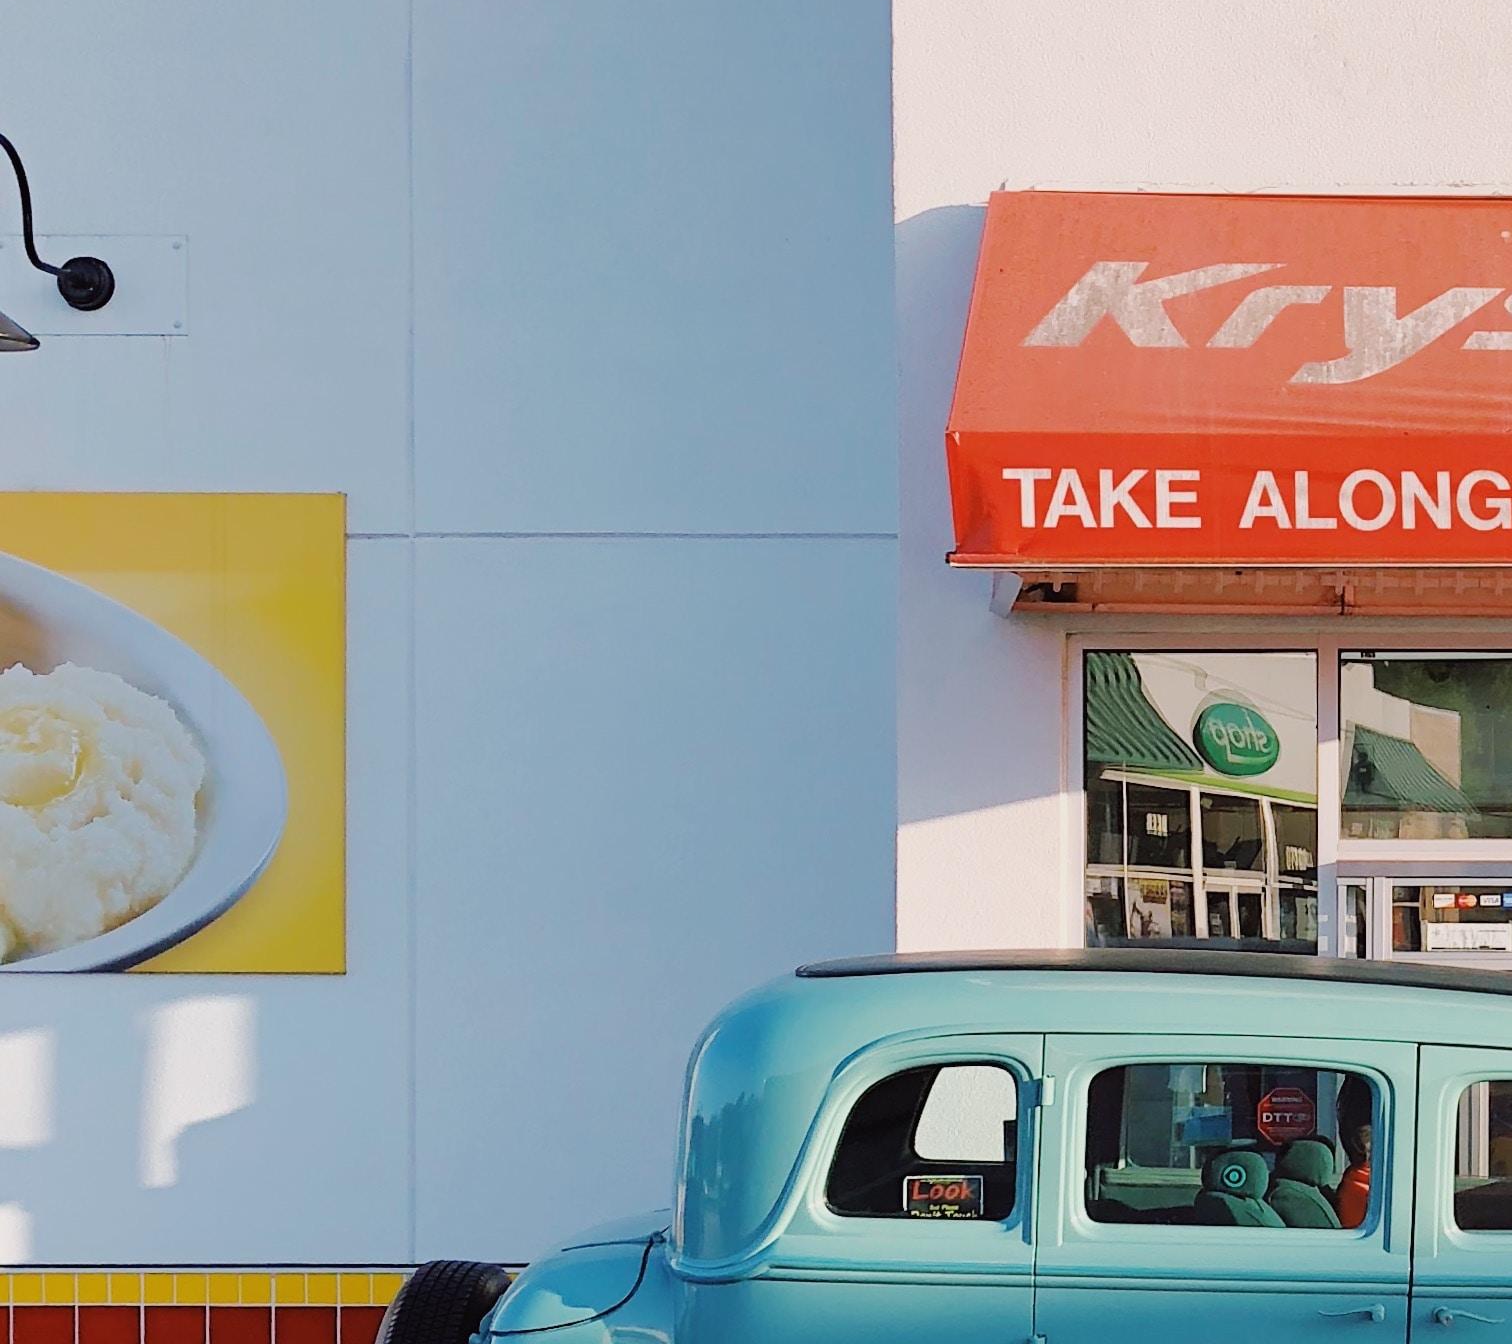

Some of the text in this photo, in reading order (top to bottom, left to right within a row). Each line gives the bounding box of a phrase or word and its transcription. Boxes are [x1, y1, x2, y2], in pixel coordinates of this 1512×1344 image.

[1002, 467, 1202, 529] TAKE
[1238, 469, 1512, 532] ALONG
[911, 1180, 974, 1200] Look
